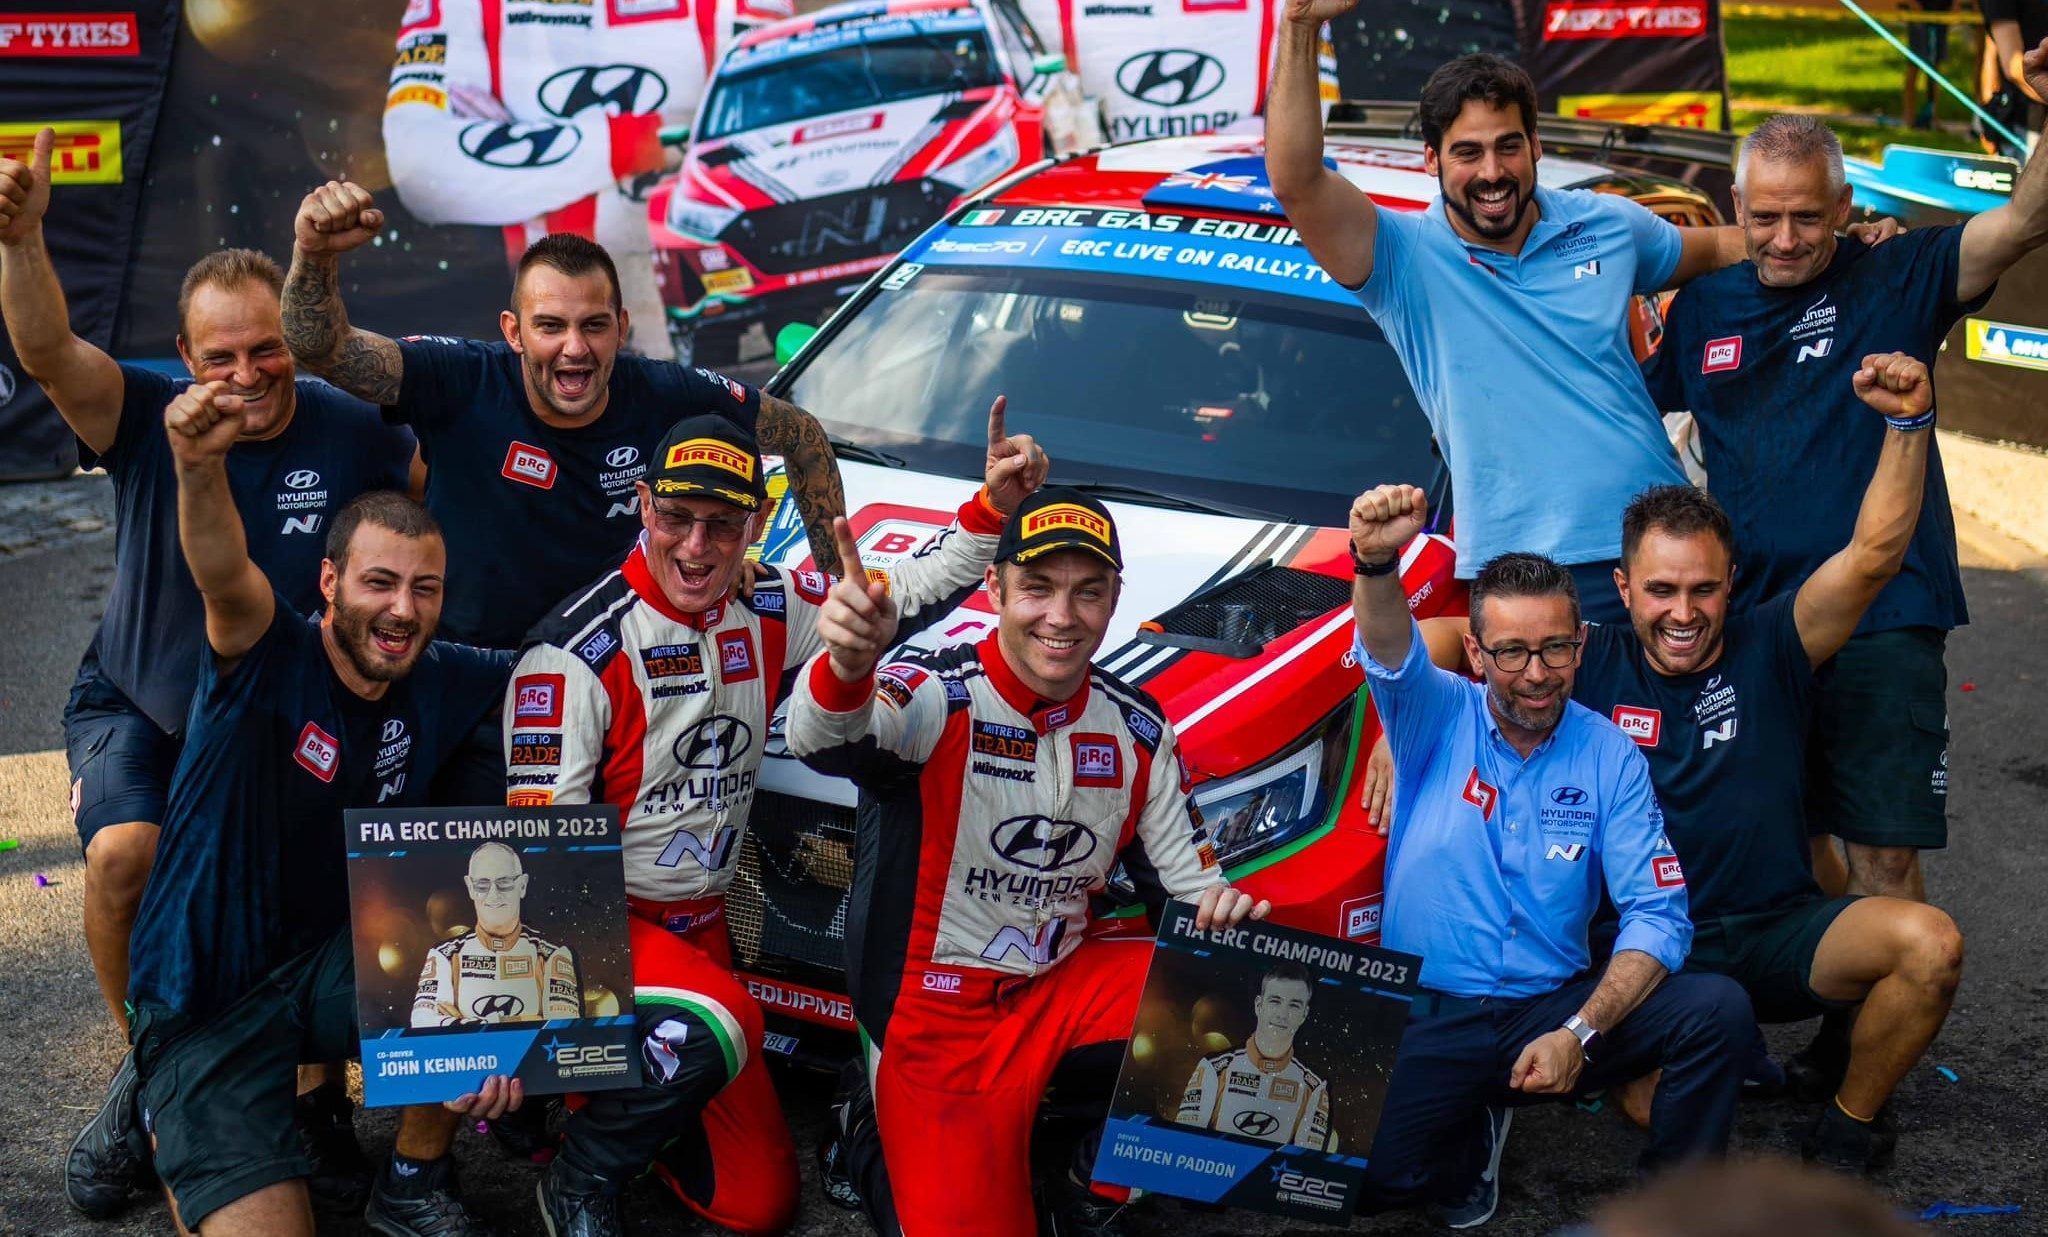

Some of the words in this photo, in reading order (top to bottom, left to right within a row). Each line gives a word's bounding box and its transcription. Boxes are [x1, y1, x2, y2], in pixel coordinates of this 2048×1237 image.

[26, 22, 130, 47] TYRES
[1010, 208, 1094, 227] BRC
[1097, 211, 1183, 233] GAS
[1061, 240, 1113, 257] ERC
[1113, 242, 1173, 261] LIVE
[1176, 248, 1215, 266] ON
[1217, 253, 1332, 284] RALLY.TV
[1711, 347, 1732, 359] BRC
[517, 456, 546, 472] BRC
[672, 443, 748, 474] PIRELLI
[599, 463, 647, 482] HYUNDAI
[277, 489, 328, 503] HYUNDAI
[277, 500, 327, 510] MOTORSPORT
[1028, 508, 1104, 536] PIRELLI
[861, 554, 893, 564] GAS
[753, 594, 785, 610] OMP
[583, 632, 612, 659] OMP
[651, 647, 676, 659] MITRE
[678, 645, 690, 656] 10
[723, 644, 746, 663] BRC
[645, 656, 701, 677] TRADE
[520, 688, 548, 706] BRC
[1695, 685, 1735, 714] HUNDAI
[982, 723, 1012, 737] MITRE
[1014, 728, 1027, 740] 10
[1129, 713, 1159, 740] OMP
[1622, 717, 1650, 731] BRC
[538, 734, 551, 745] 10
[974, 733, 1036, 760] TRADE
[307, 739, 332, 763] BRC
[511, 746, 561, 764] RADE
[1079, 748, 1112, 766] BRC
[646, 769, 757, 802] HYUNDAI
[644, 803, 684, 814] NEW
[1541, 809, 1596, 821] HYUNDAI
[360, 822, 395, 842] FIA
[400, 821, 440, 841] ERC
[445, 818, 550, 840] CHAMPION
[557, 817, 609, 837] 2023
[1541, 819, 1594, 828] MOTORSPORT
[964, 886, 1001, 903] NEW
[1352, 909, 1379, 927] BRC
[1173, 916, 1204, 940] FIA
[1210, 928, 1250, 949] ERC
[1252, 934, 1354, 973] CHAMPION
[1356, 958, 1409, 985] 2023
[462, 960, 496, 970] TRADE
[923, 974, 961, 990] OMP
[748, 980, 854, 1022] EQUIPME
[376, 1050, 414, 1060] CO-DRIVER
[556, 1044, 627, 1065] ERC
[378, 1060, 420, 1078] JOHN
[425, 1055, 498, 1074] KENNARD
[1117, 1133, 1141, 1143] DRIVER
[1113, 1142, 1173, 1167] HAYDEN
[1176, 1154, 1236, 1179] PADDON
[1280, 1172, 1347, 1199] ERC
